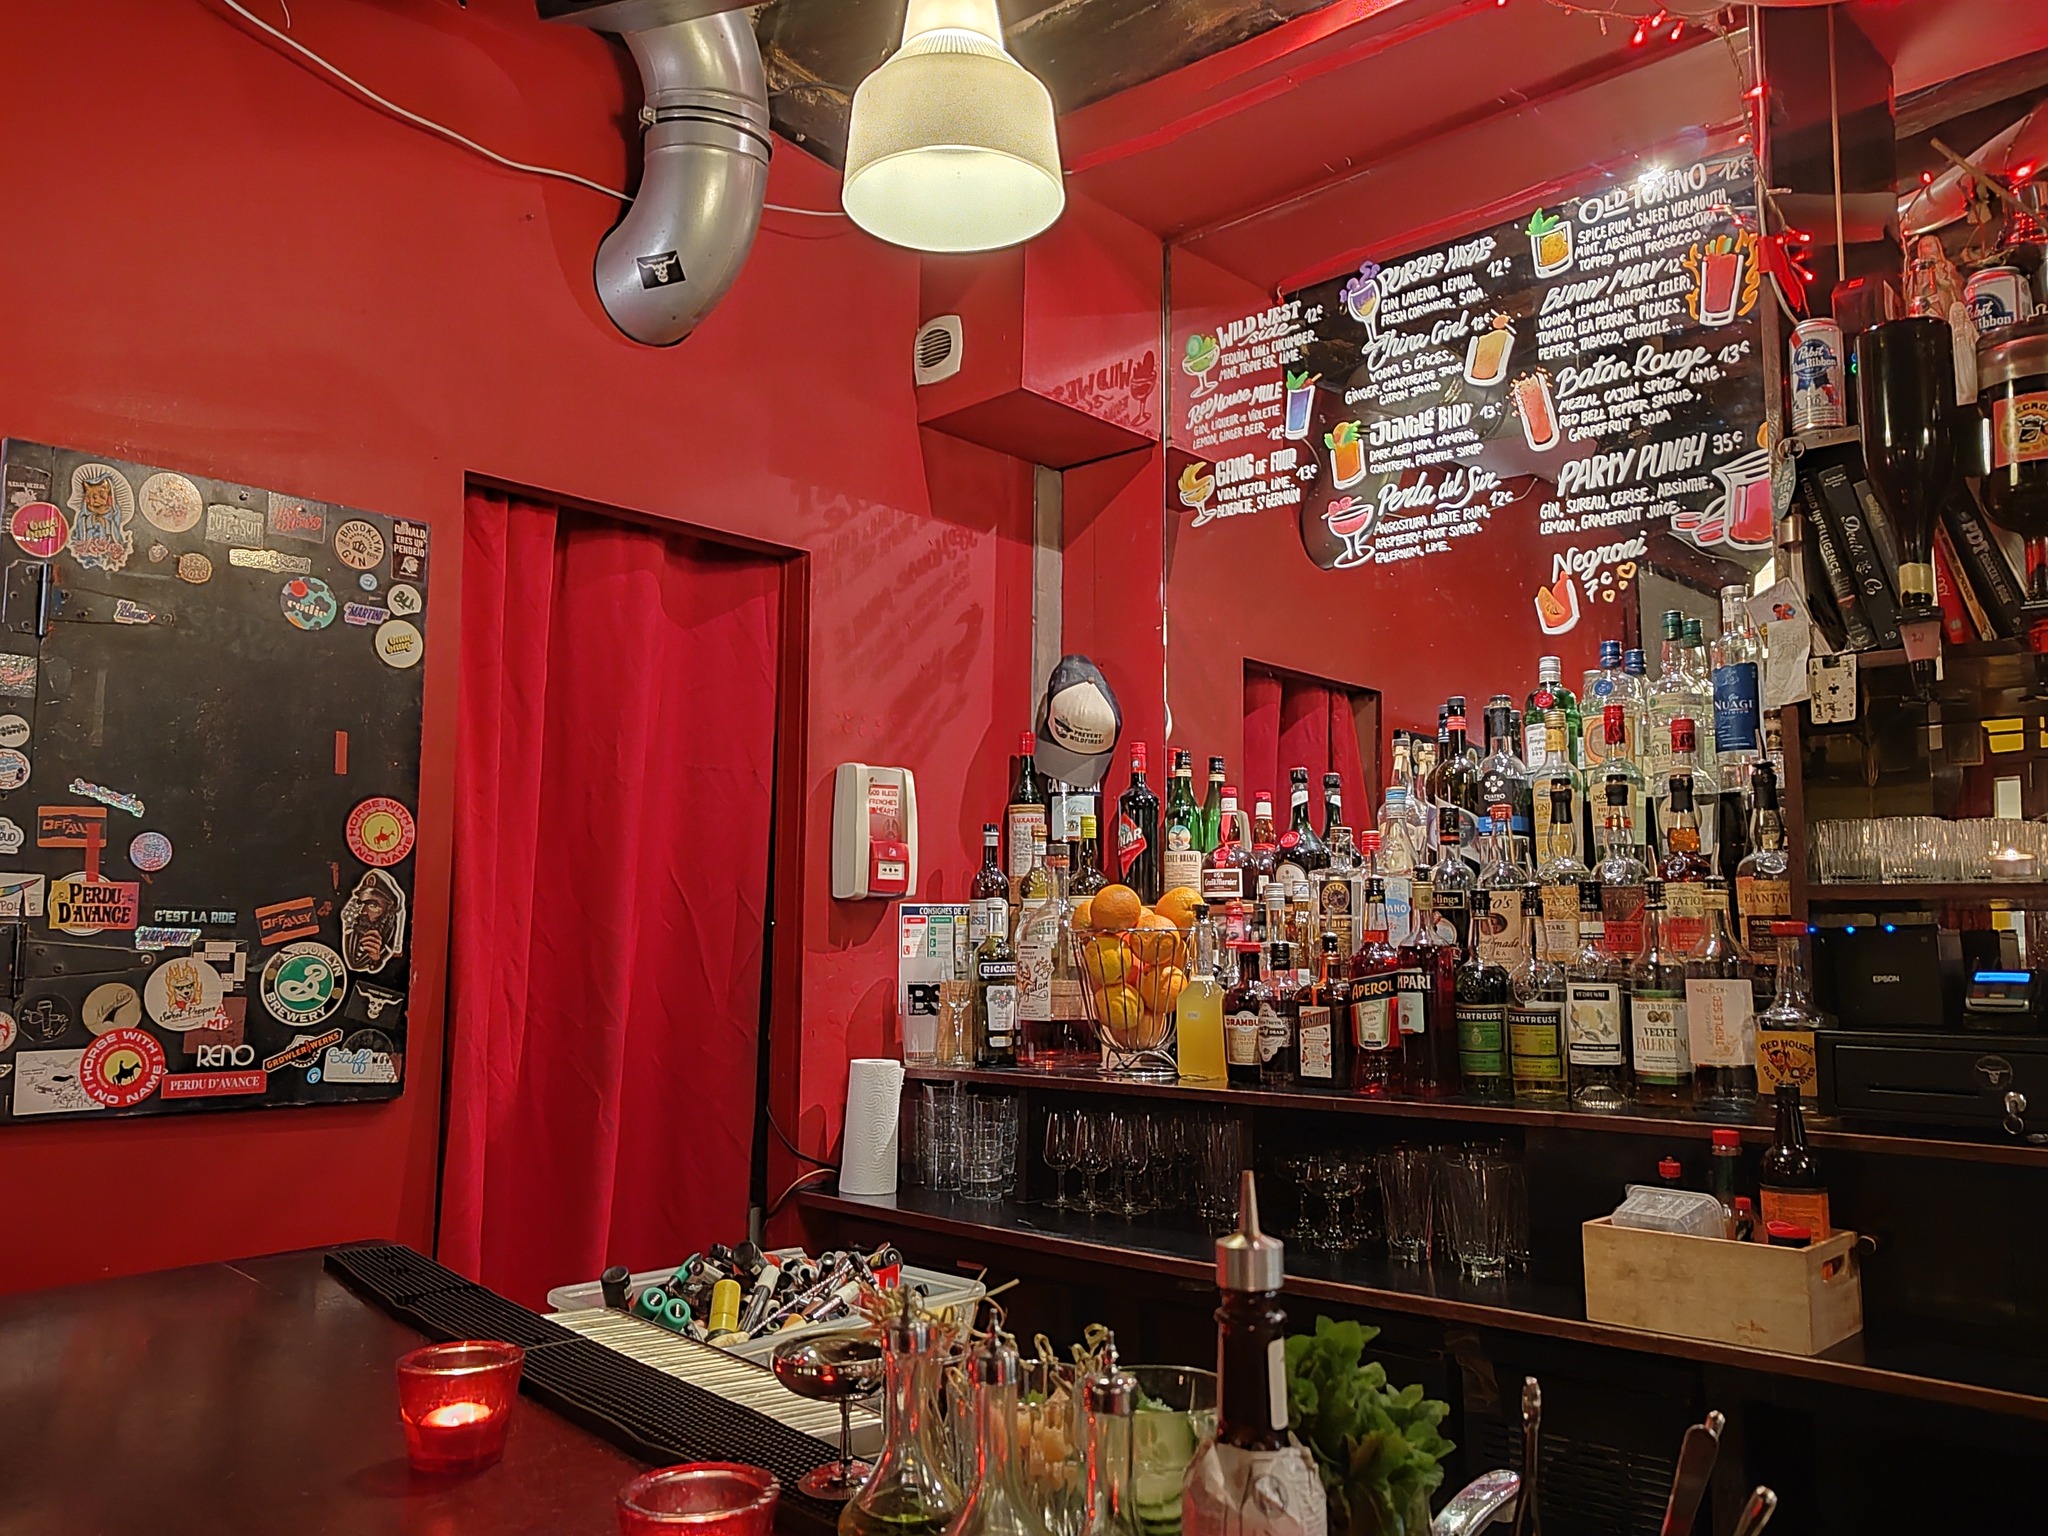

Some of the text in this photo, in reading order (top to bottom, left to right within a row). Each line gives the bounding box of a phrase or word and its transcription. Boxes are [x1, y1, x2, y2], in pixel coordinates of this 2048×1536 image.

[1578, 187, 1630, 224] OLD
[1377, 252, 1445, 297] PURPLE
[1444, 236, 1497, 273] HAZE
[1540, 258, 1666, 316] BLOODY MARY
[1381, 295, 1399, 313] GIN
[1966, 301, 1994, 320] Pabst
[1216, 300, 1301, 349] WILD WEST
[1238, 322, 1300, 347] side
[1798, 346, 1825, 361] Pabst
[1806, 357, 1836, 367] Ribbon
[1555, 354, 1632, 400] Baton
[1633, 344, 1712, 379] Rouge
[1249, 381, 1283, 406] MULE
[1438, 402, 1472, 432] BIRD
[1215, 453, 1255, 487] GANG
[1557, 448, 1637, 497] PARTY
[1635, 431, 1708, 481] PUNCH
[1438, 468, 1464, 500] del
[341, 523, 382, 554] BROOKLYN
[394, 544, 425, 557] PENDEJO
[1811, 510, 1841, 576] INTELLIGENCE
[341, 549, 366, 567] GIN
[1552, 530, 1648, 584] Negroni
[1073, 730, 1102, 739] PREVENT
[349, 800, 412, 837] HORSE WITH
[355, 836, 413, 865] NO NAME
[1119, 828, 1142, 848] NAR
[68, 882, 122, 905] PERDU
[57, 902, 131, 925] D'AVANCE
[155, 910, 237, 923] C'EST LA RIDE
[919, 907, 962, 915] CONSIGNES DE
[282, 945, 343, 977] BROOKLYN
[983, 965, 1017, 974] RICARD
[1352, 980, 1394, 1000] APEROL
[1873, 975, 1900, 983] EPSON
[266, 991, 326, 1023] BREWERY
[1456, 1010, 1557, 1025] CHARTREUSE CHARTREUSE
[1226, 1018, 1258, 1027] DRAMBU
[1644, 1028, 1677, 1038] VELVET
[1714, 996, 1725, 1047] TRIPLE SEC
[83, 1031, 158, 1081] HORSE WITH
[197, 1045, 255, 1067] RENO
[266, 1031, 340, 1069] GROWLER WERKS
[1760, 1040, 1814, 1056] RED HOUSE
[94, 1065, 161, 1104] NO NAME
[170, 1076, 260, 1091] PERDU D'AVANCE
